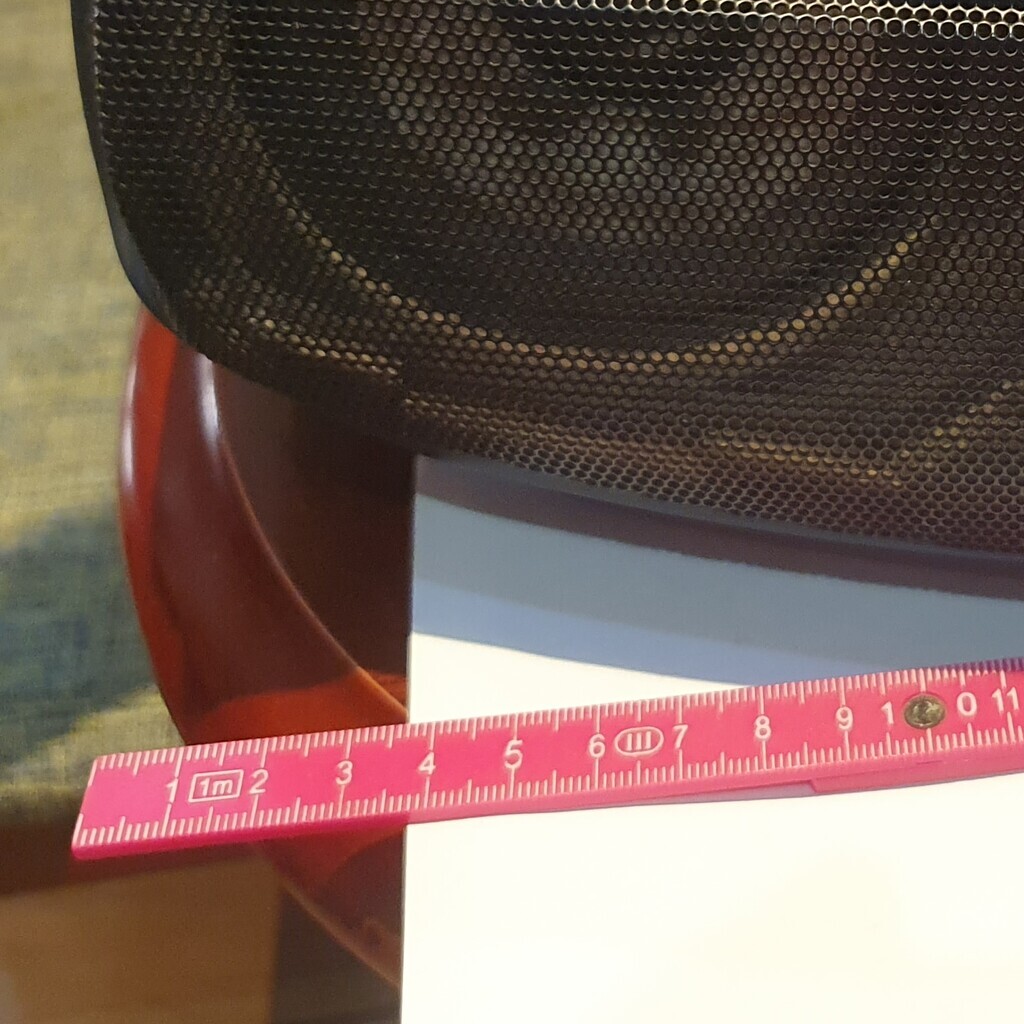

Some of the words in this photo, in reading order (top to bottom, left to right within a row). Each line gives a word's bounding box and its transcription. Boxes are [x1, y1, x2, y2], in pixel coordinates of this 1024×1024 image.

[249, 771, 269, 794] 2
[335, 761, 354, 784] 3
[417, 752, 436, 775] 4
[503, 740, 523, 768] 5
[588, 734, 605, 757] 6
[672, 725, 688, 748] 7
[753, 715, 772, 739] 8
[835, 707, 853, 730] 9
[991, 688, 1019, 712] 11
